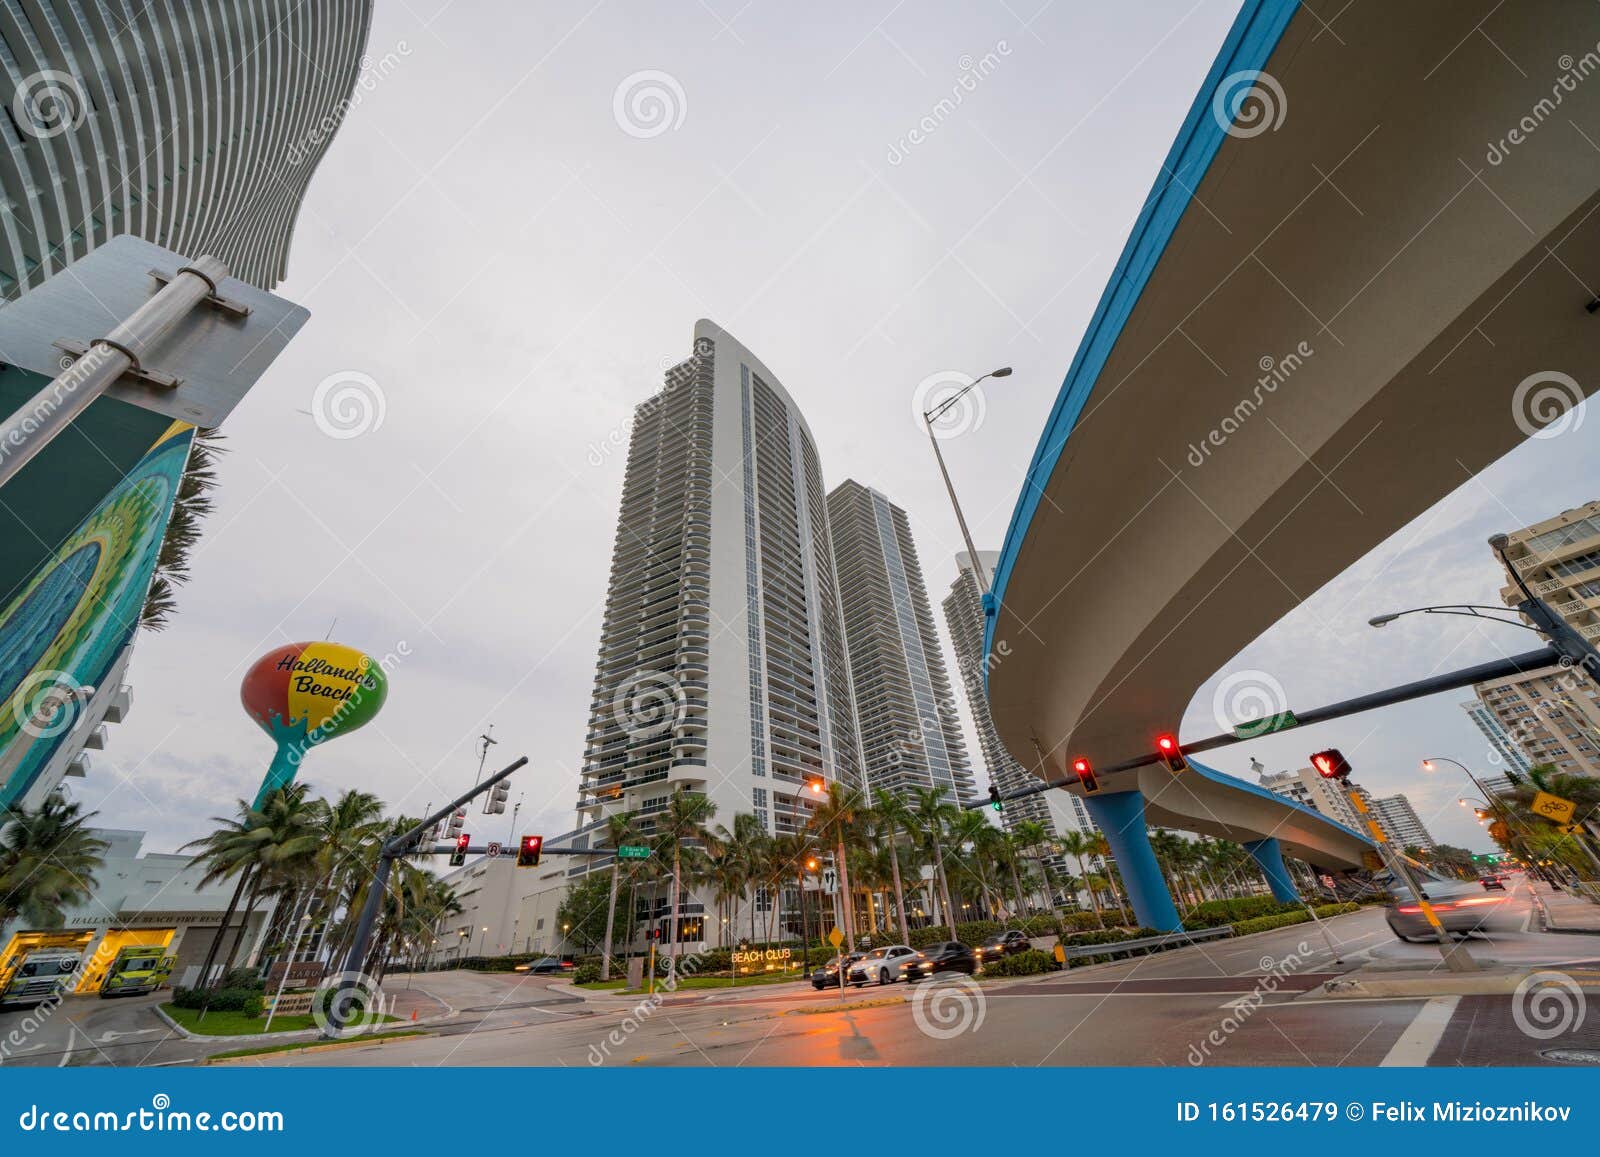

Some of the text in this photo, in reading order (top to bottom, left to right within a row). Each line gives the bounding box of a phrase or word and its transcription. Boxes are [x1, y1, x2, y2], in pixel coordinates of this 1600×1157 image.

[294, 676, 352, 702] Beach
[731, 948, 791, 963] BEACH CLUB
